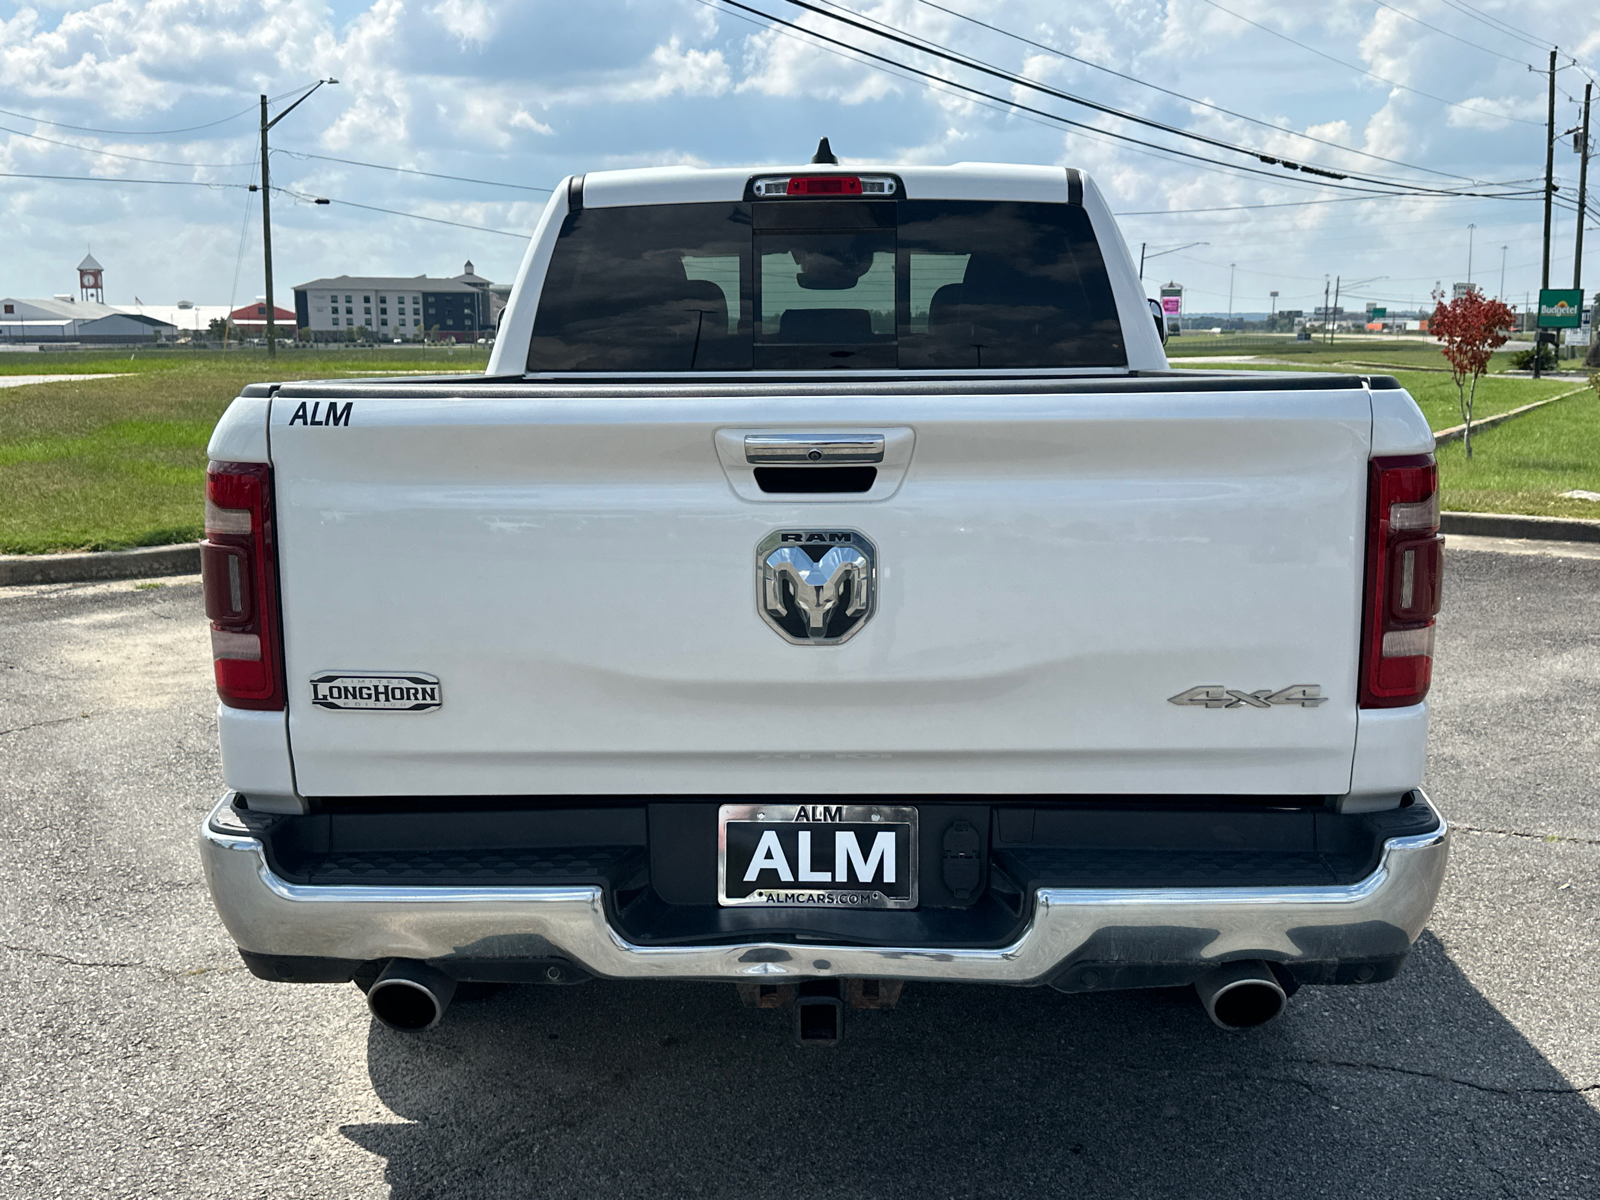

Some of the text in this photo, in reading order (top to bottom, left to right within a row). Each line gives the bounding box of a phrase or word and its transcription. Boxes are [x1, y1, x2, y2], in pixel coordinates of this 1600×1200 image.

[1541, 305, 1577, 317] Budgetel
[288, 401, 354, 426] ALM
[781, 533, 852, 542] RAM
[311, 683, 437, 702] LONGHORN
[794, 805, 843, 822] ALM
[742, 830, 896, 883] ALM
[765, 893, 871, 904] ALMCARS.COM
